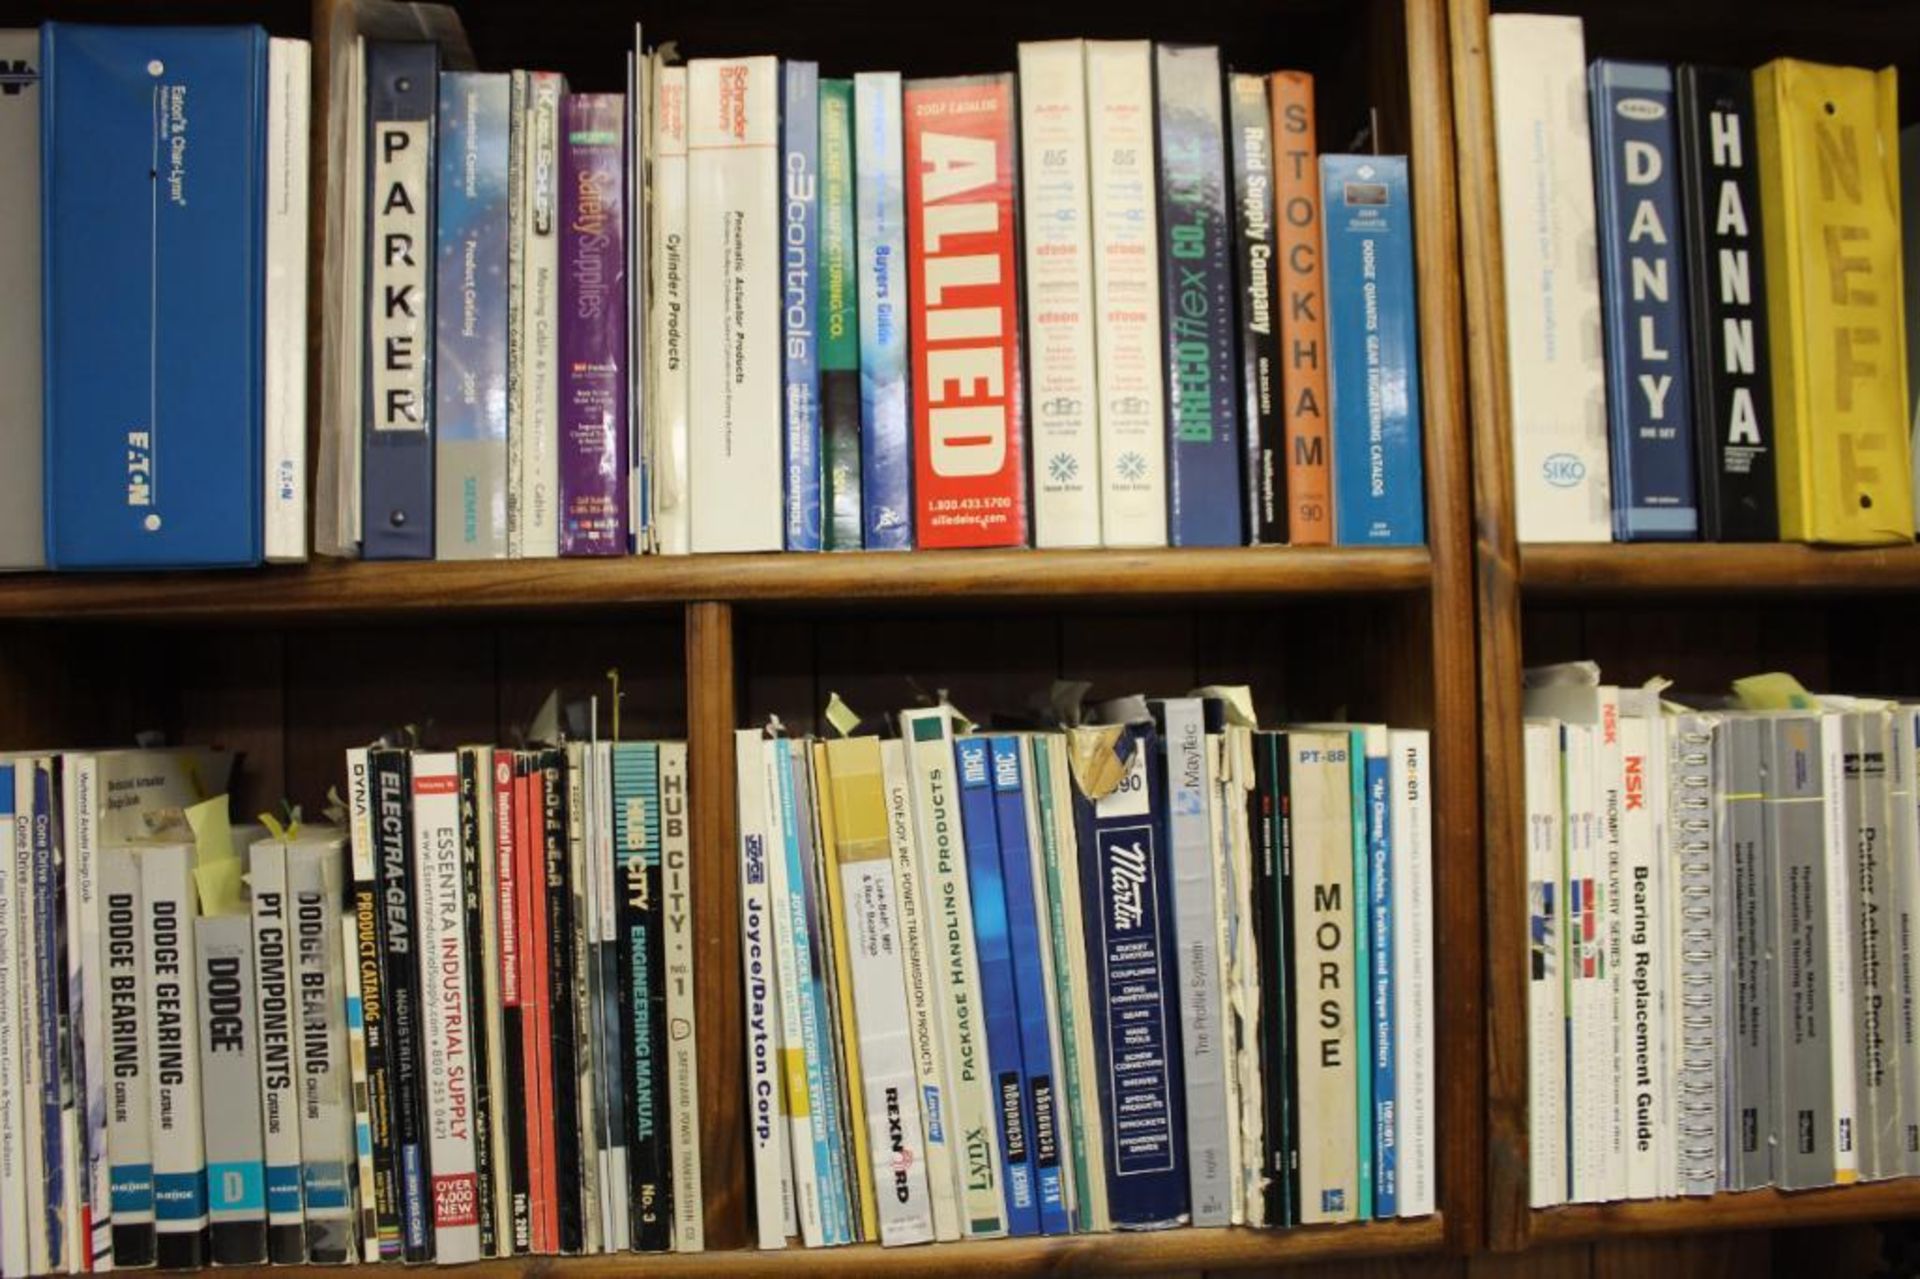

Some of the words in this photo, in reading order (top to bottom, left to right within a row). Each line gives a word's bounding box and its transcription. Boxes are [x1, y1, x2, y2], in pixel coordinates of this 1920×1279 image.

[734, 64, 749, 141] Schrader
[1245, 126, 1265, 170] Reid
[464, 151, 478, 197] Control
[1245, 173, 1269, 240] Supply
[465, 240, 477, 286] Product
[667, 233, 684, 297] Cylinder
[734, 210, 745, 272] Pneumatic
[1363, 239, 1376, 279] DODGE
[384, 131, 416, 423] PARKER
[874, 244, 892, 299] Buyers
[1249, 243, 1273, 334] Company
[1285, 104, 1324, 467] STOCKHAM
[1624, 141, 1672, 420] DANLY
[1710, 112, 1762, 445] HANNA
[463, 288, 479, 337] Catalog
[734, 276, 745, 327] Actuator
[829, 313, 844, 340] CO.
[877, 302, 893, 345] Guide
[920, 131, 1007, 478] ALLIED
[1363, 282, 1378, 331] QUANTIS
[1813, 120, 1887, 517] NEFF
[536, 320, 550, 355] Cable
[668, 301, 681, 371] Products
[734, 331, 746, 384] Products
[1366, 335, 1380, 366] GEAR
[1368, 367, 1382, 441] ENGINEERING
[128, 432, 150, 505] EATON
[1371, 445, 1384, 498] CATALOG
[1543, 462, 1585, 482] SIKO
[534, 483, 548, 527] Cables
[1301, 504, 1323, 521] 90
[1603, 703, 1618, 745] NSK
[962, 748, 986, 783] MAC
[996, 753, 1020, 786] MAC
[1183, 723, 1199, 788] MayTec
[1300, 750, 1346, 763] PT-88
[1407, 747, 1419, 801] nexen
[663, 775, 685, 837] HUB
[1624, 755, 1645, 811] NSK
[17, 815, 29, 849] Cone
[36, 814, 48, 848] Cone
[499, 791, 510, 844] Industrial
[627, 797, 648, 849] HUB
[929, 768, 950, 874] PRODUCTS
[1606, 789, 1619, 844] PROMPT
[18, 851, 30, 885] Drive
[37, 851, 50, 885] Drive
[379, 770, 408, 954] ELECTRA-GEAR
[500, 846, 510, 878] Power
[745, 834, 765, 884] JOYCE
[898, 848, 910, 871] INC.
[1735, 841, 1744, 863] and
[1747, 841, 1756, 898] Industrial
[1858, 826, 1877, 897] Parker
[82, 880, 92, 904] Guide
[436, 826, 460, 932] ESSENTRA
[627, 854, 649, 911] CITY
[667, 851, 687, 933] CITY
[862, 874, 871, 882] &
[902, 873, 917, 917] POWER
[1109, 841, 1146, 931] Martin
[1608, 851, 1620, 914] DELIVERY
[1803, 865, 1813, 922] Hydraulic
[109, 893, 135, 968] DODGE
[257, 892, 282, 920] PT
[298, 894, 322, 965] DODGE
[356, 890, 374, 958] PRODUCT
[501, 879, 514, 951] Transmission
[1377, 906, 1388, 947] Brakes
[1631, 865, 1649, 946] Bearing
[1901, 912, 1910, 950] Motion
[153, 901, 179, 976] DODGE
[866, 911, 879, 957] Bearings
[943, 881, 967, 986] HANDLING
[1610, 920, 1621, 968] SERIES
[1804, 925, 1815, 968] Pumps,
[505, 954, 518, 1001] Products
[676, 975, 686, 996] 1
[748, 897, 772, 1074] Joyce/Dayton
[907, 918, 926, 1009] TRANSMISSION
[1190, 940, 1205, 988] System
[1314, 883, 1343, 1067] MORSE
[1378, 949, 1388, 974] and
[1750, 959, 1759, 1003] Pumps,
[1902, 952, 1911, 994] Control
[206, 956, 244, 1053] DODGE
[257, 925, 291, 1090] COMPONENTS
[361, 960, 381, 1021] CATALOG
[441, 935, 467, 1061] INDUSTRIAL
[630, 925, 651, 1056] ENGINEERING
[1192, 991, 1208, 1034] Profile
[1376, 977, 1390, 1018] Torque
[1738, 982, 1747, 1036] Products
[1806, 970, 1815, 1012] Motors
[110, 974, 139, 1078] BEARING
[155, 980, 184, 1085] GEARING
[300, 973, 330, 1075] BEARING
[916, 1010, 935, 1076] PRODUCTS
[959, 993, 976, 1081] PACKAGE
[1125, 1027, 1149, 1036] HAND
[1125, 1035, 1151, 1044] TOOLS
[1633, 952, 1651, 1086] Replacement
[1751, 1006, 1760, 1047] Motors
[1794, 991, 1803, 1044] Products
[1806, 1015, 1816, 1038] and
[1903, 996, 1913, 1045] Systems
[430, 1049, 445, 1075] 800
[799, 991, 818, 1066] ACTUATORS
[809, 1084, 826, 1144] SYSTEMS
[1115, 1059, 1164, 1071] CONVEYORS
[1195, 1036, 1209, 1056] The
[1380, 1021, 1391, 1068] Limiters
[115, 1081, 127, 1123] CATALOG
[160, 1088, 173, 1131] CATALOG
[267, 1092, 281, 1134] CATALOG
[306, 1078, 320, 1120] CATALOG
[433, 1108, 446, 1141] 0421
[448, 1065, 468, 1141] SUPPLY
[635, 1059, 653, 1142] MANUAL
[754, 1079, 772, 1148] Corp.
[1003, 1083, 1024, 1157] Technology
[1035, 1086, 1056, 1161] Technology
[1119, 1100, 1164, 1113] PRODUCTS
[1119, 1117, 1167, 1129] SPROCKETS
[1636, 1093, 1653, 1153] Guide
[679, 1112, 691, 1145] POWER
[435, 1179, 471, 1193] OVER
[437, 1202, 471, 1216] NEW
[641, 1183, 656, 1209] No.
[681, 1150, 694, 1221] TRANSMISSION
[642, 1212, 656, 1223] 3
